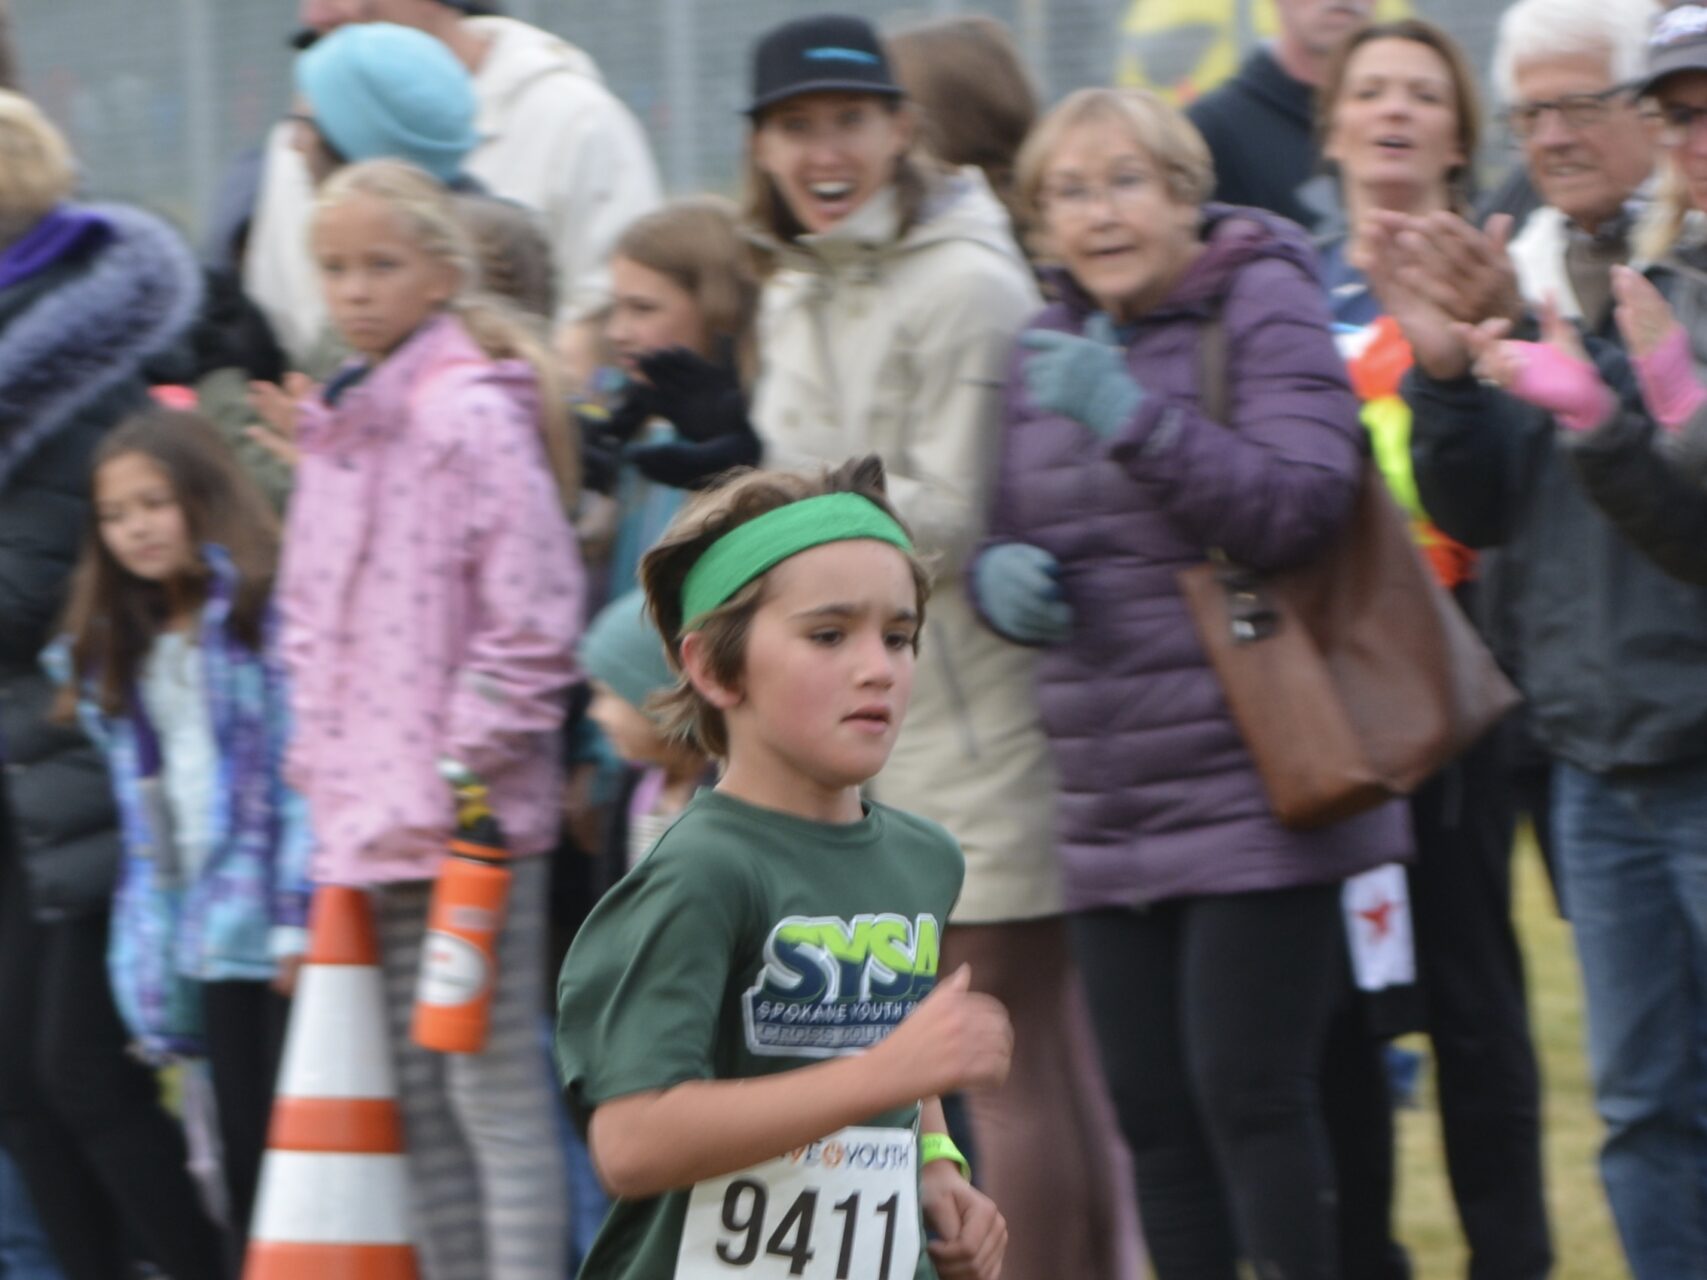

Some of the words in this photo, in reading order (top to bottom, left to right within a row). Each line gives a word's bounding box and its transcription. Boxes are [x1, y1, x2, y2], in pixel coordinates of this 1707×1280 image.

[765, 915, 940, 998] SYSA
[756, 1001, 848, 1023] SPOKANE
[851, 1002, 900, 1021] YOUTH
